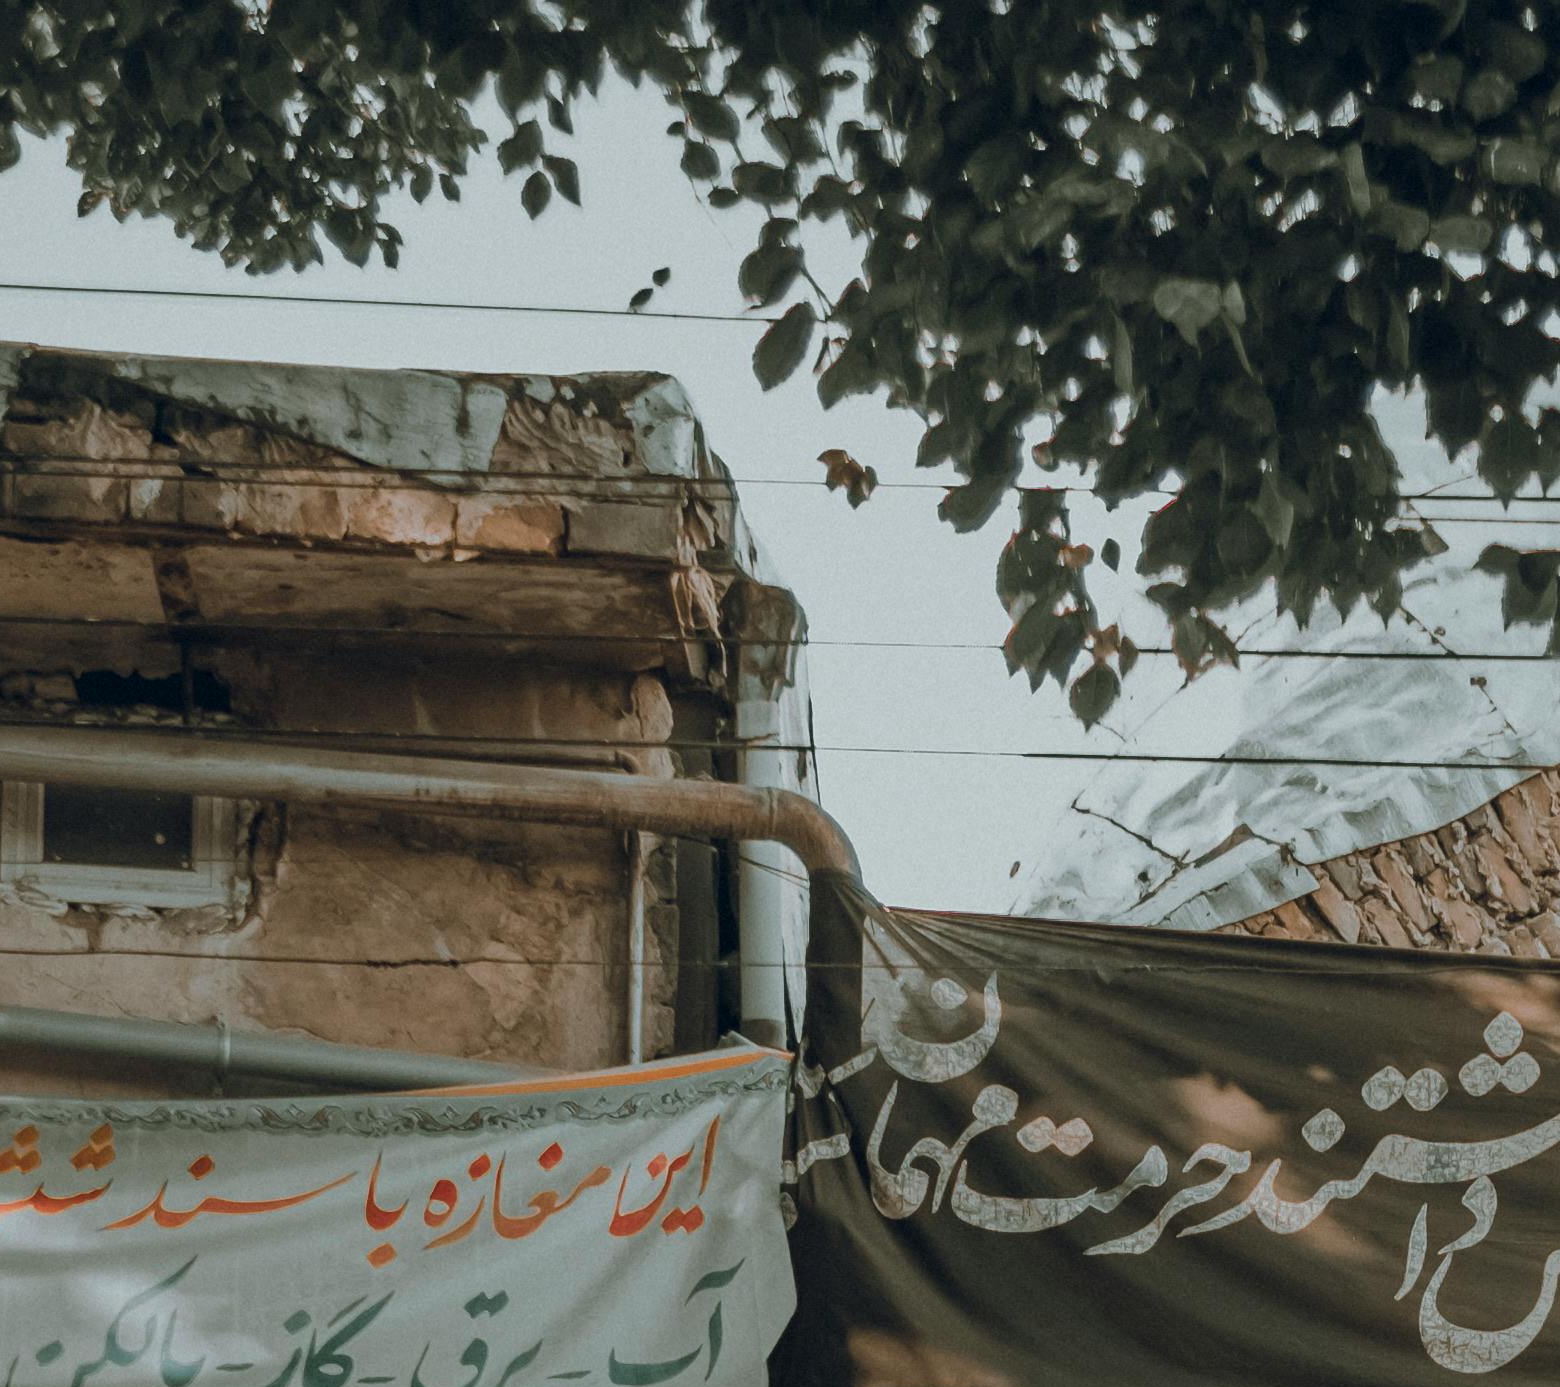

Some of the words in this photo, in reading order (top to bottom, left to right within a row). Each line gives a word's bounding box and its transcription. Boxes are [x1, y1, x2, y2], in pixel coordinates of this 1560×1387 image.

[105, 1153, 358, 1232] سند
[365, 1151, 409, 1269] با
[424, 1141, 612, 1251] مغازه
[608, 1116, 721, 1238] این
